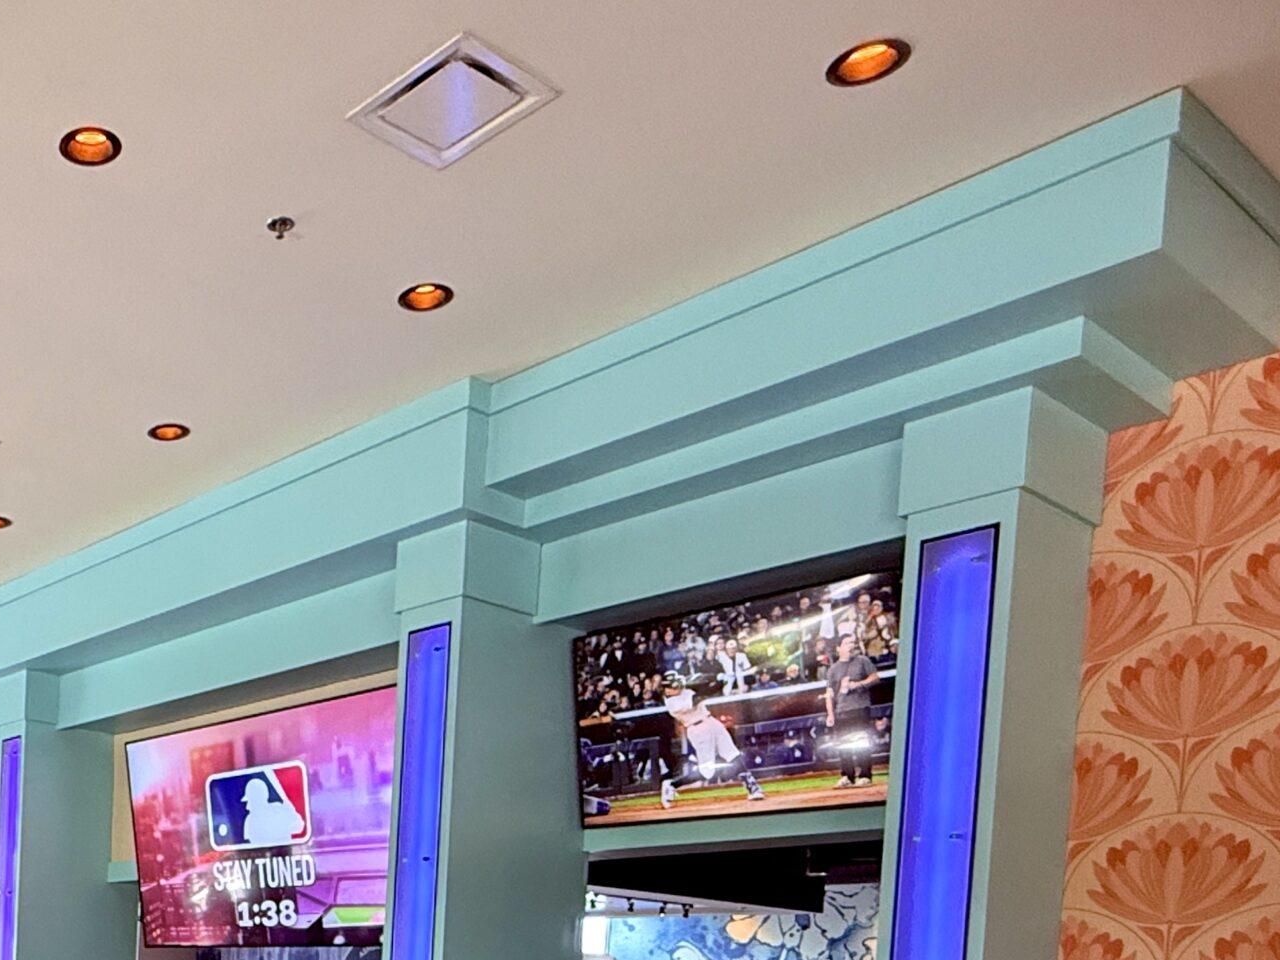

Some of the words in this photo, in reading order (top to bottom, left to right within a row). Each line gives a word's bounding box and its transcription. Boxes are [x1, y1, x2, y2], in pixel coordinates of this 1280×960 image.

[213, 859, 252, 891] STAY
[255, 854, 316, 888] TUNED
[238, 899, 298, 928] 1:38
